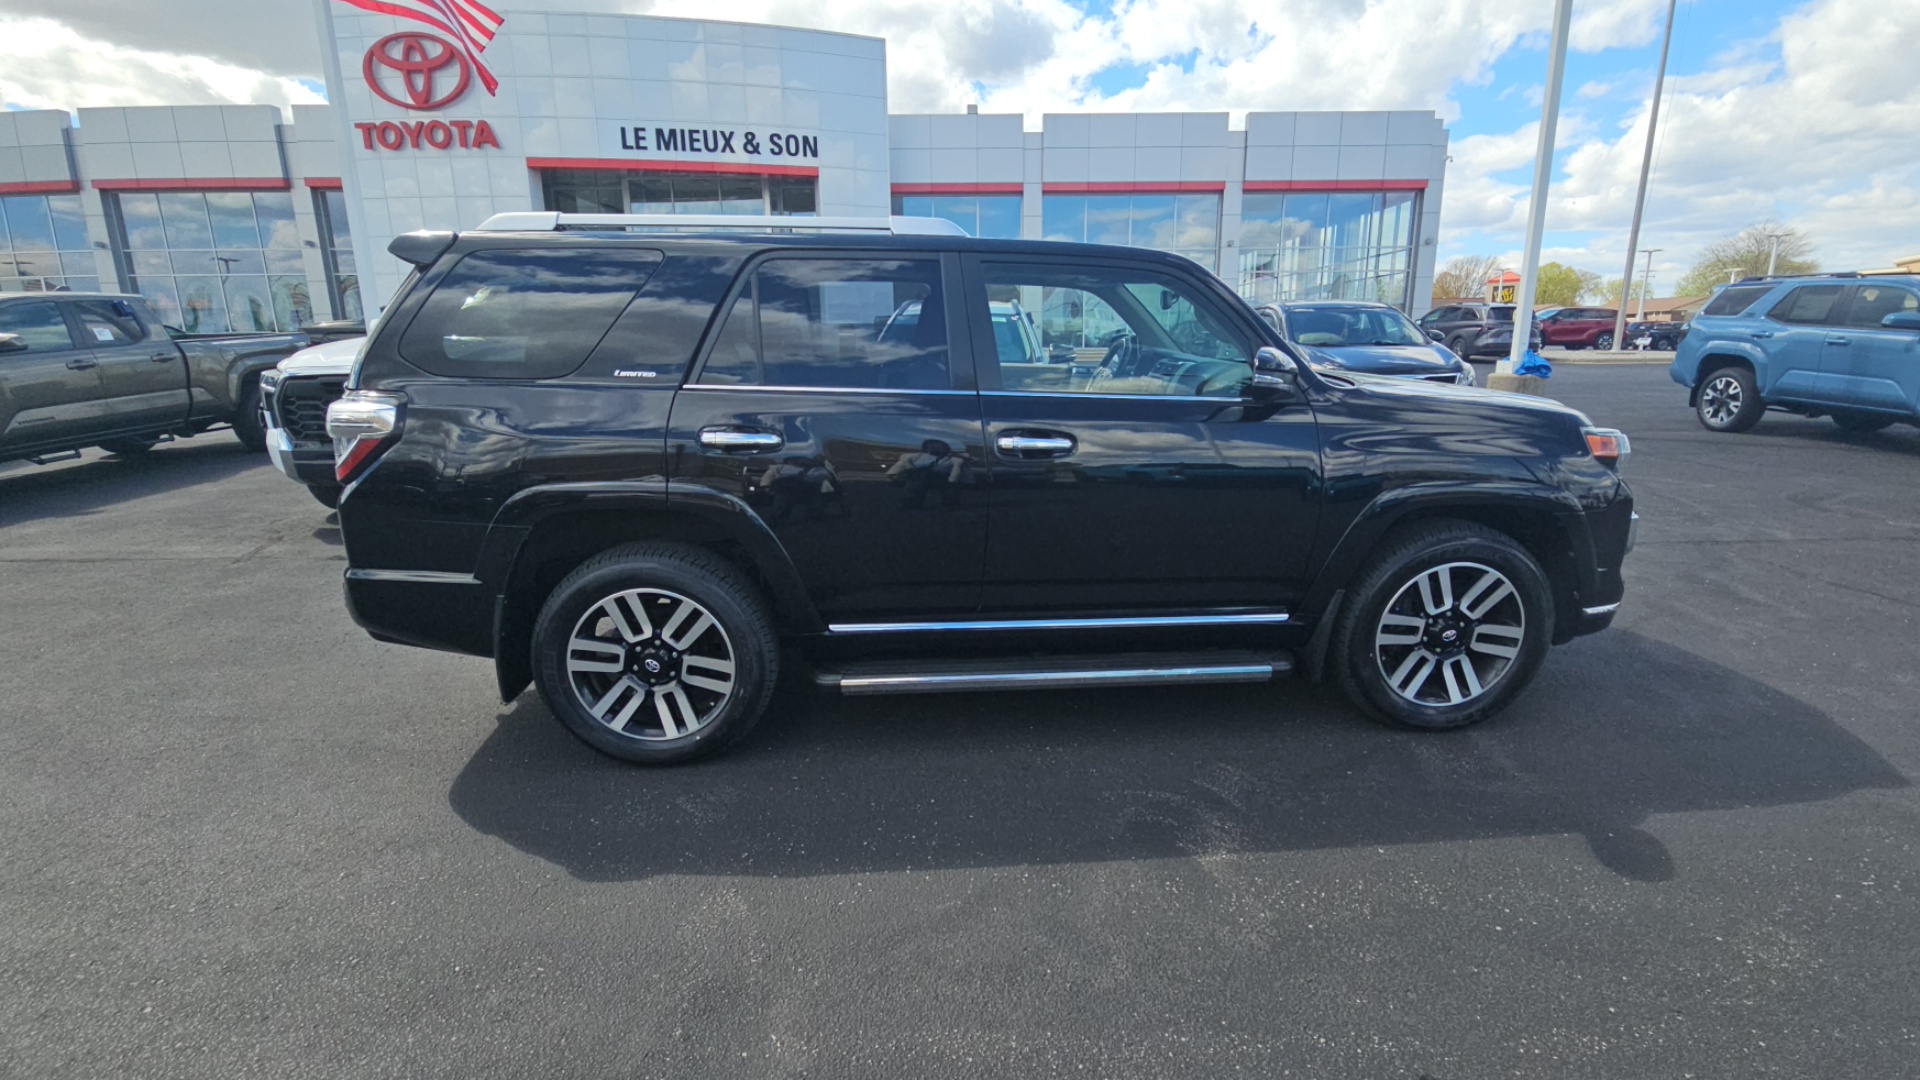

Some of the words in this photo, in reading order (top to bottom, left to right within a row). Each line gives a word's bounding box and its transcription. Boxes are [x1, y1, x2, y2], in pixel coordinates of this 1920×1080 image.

[354, 120, 500, 150] TOYOTA
[620, 126, 648, 150] LE
[655, 127, 736, 154] MIEUX
[742, 131, 762, 155] &
[769, 132, 819, 158] SON
